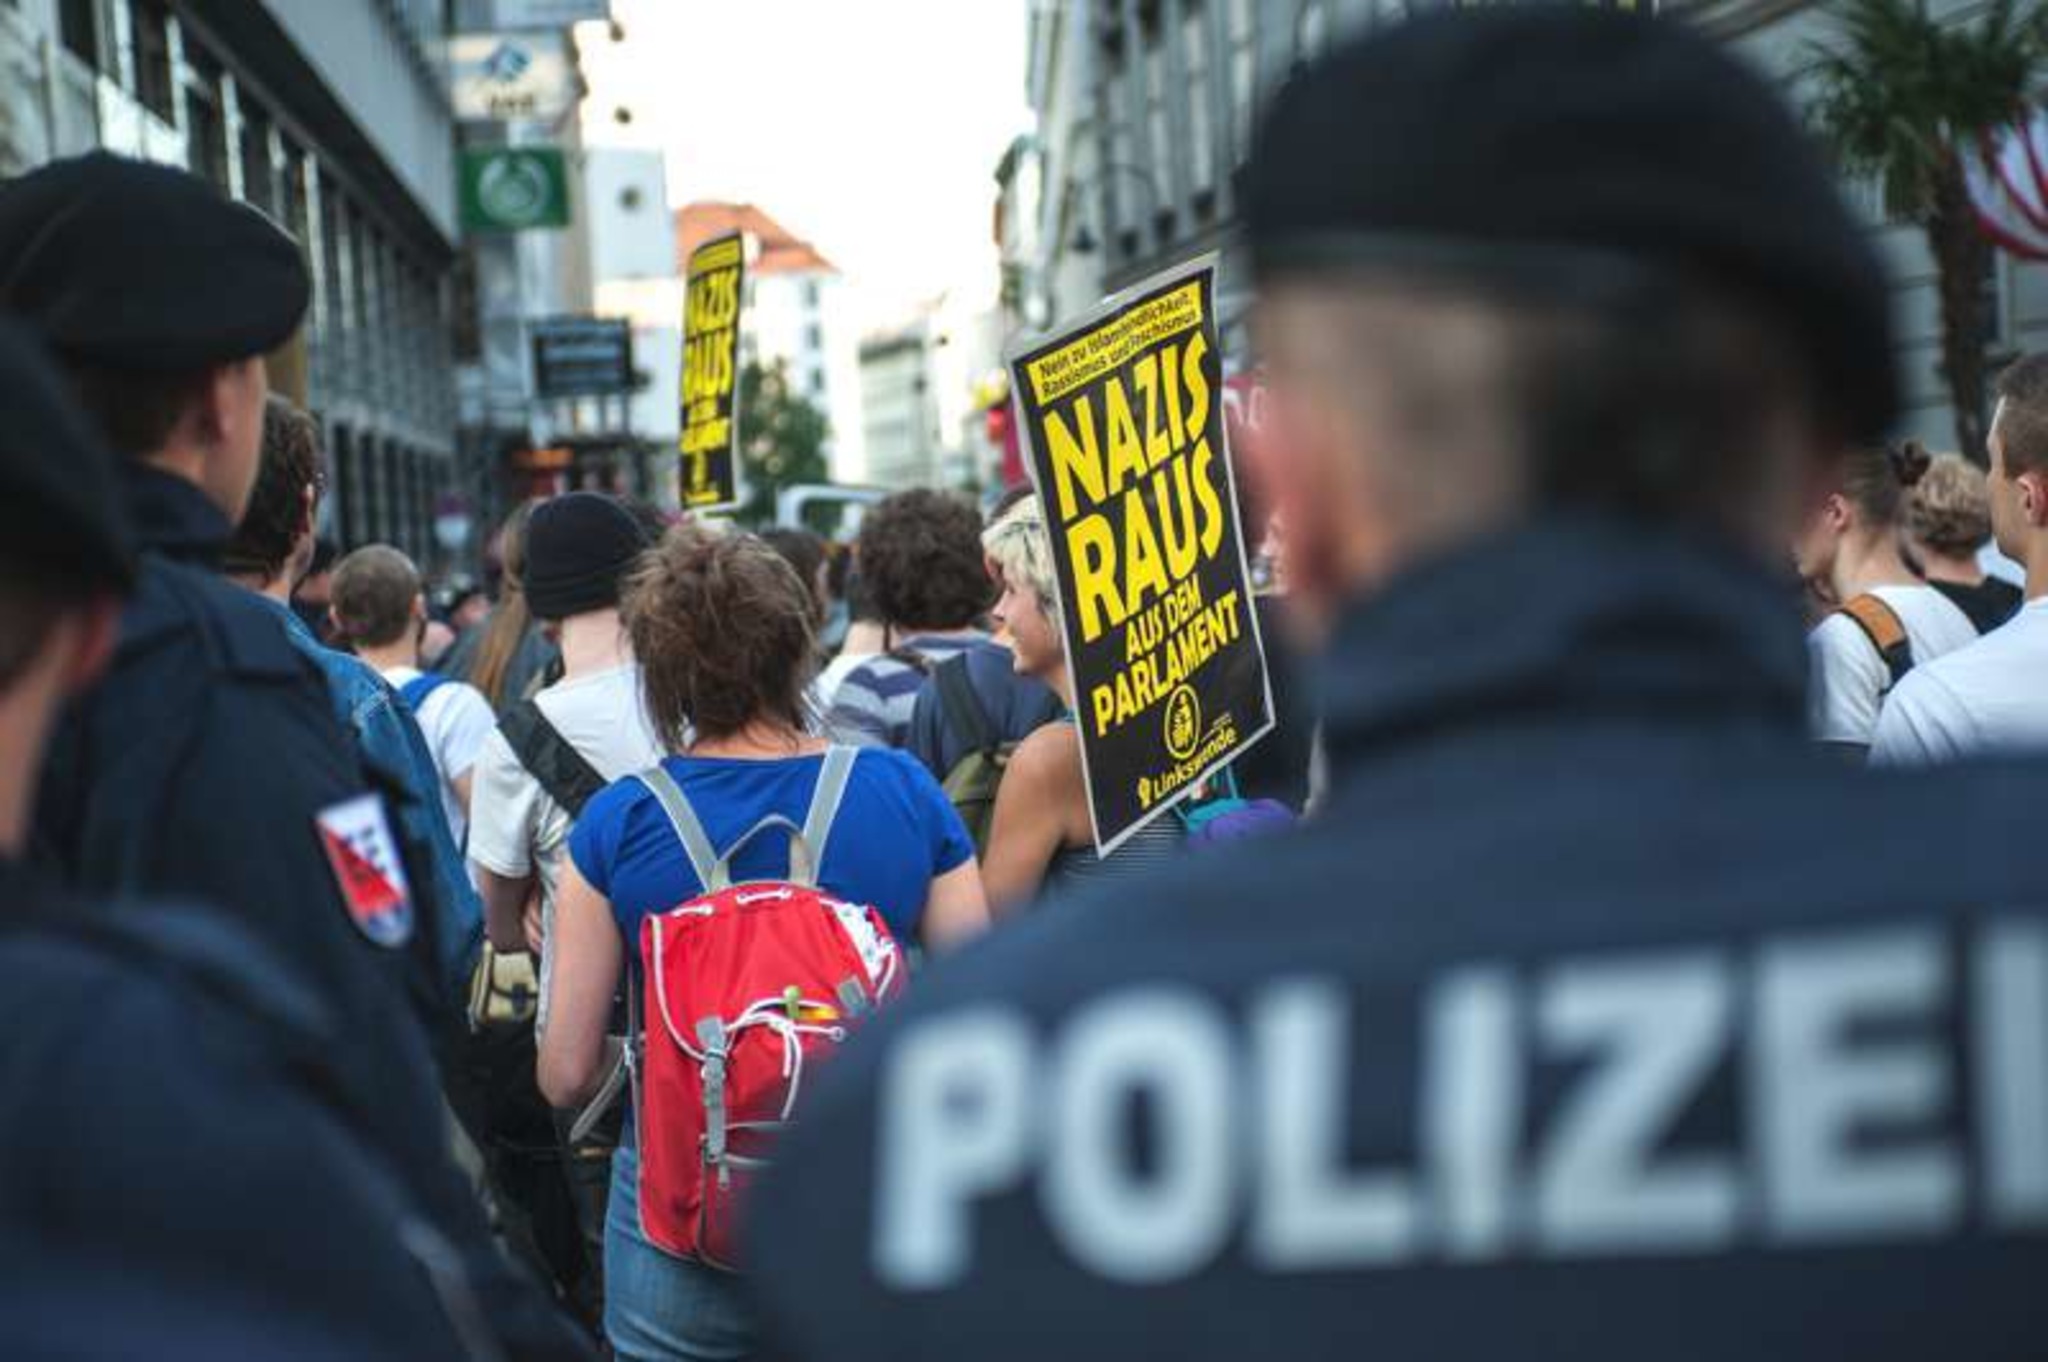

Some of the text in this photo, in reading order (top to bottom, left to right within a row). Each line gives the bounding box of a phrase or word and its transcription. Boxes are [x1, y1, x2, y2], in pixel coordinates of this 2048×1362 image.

[1040, 352, 1069, 377] Nein
[1071, 346, 1087, 363] zu
[1042, 354, 1107, 395] Rassismus
[1109, 343, 1130, 364] und
[1043, 331, 1209, 521] NAZIS
[1066, 437, 1223, 643] RAUS
[1092, 590, 1239, 737] PARLAMENT
[1126, 573, 1201, 663] AUS DEM
[874, 920, 2048, 1289] POLIZEI
